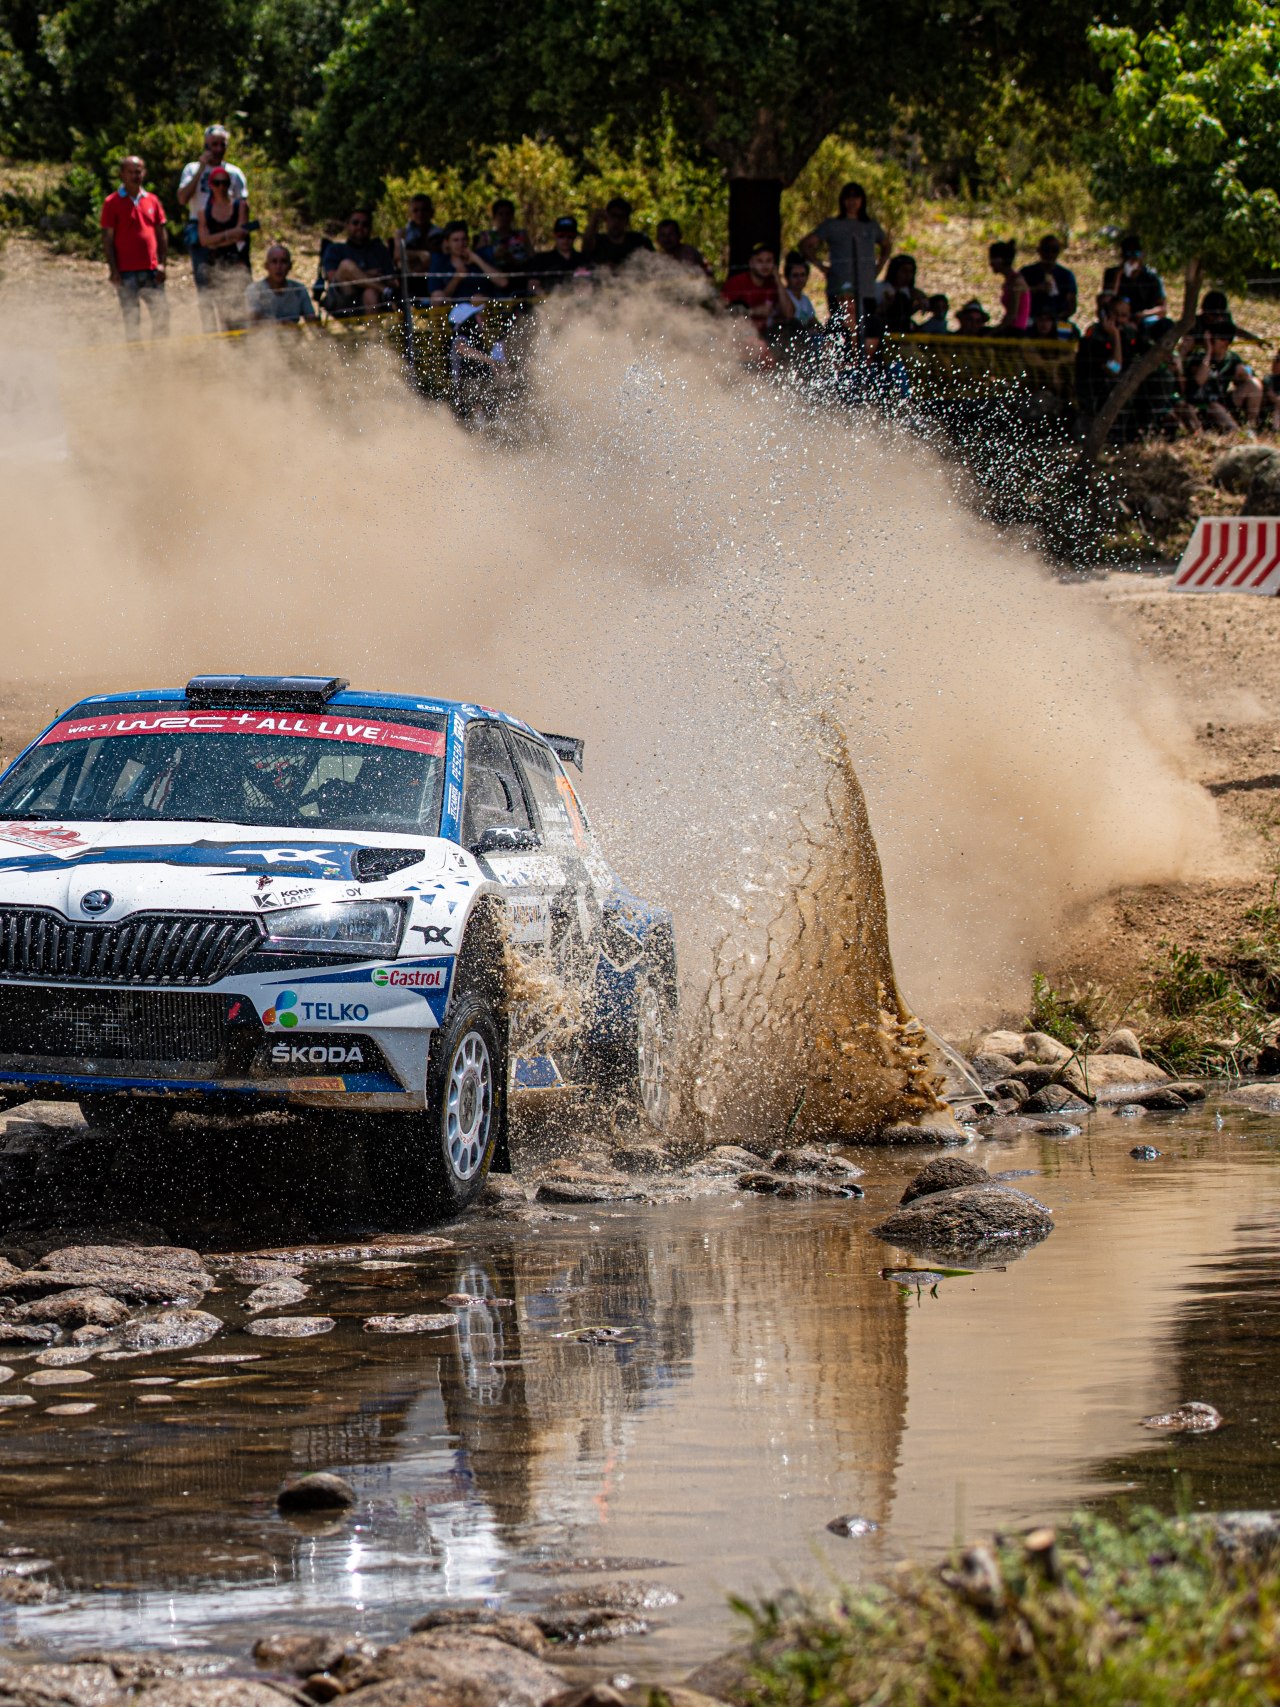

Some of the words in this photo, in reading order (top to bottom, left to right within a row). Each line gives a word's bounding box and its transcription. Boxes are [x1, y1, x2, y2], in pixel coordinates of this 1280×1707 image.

[68, 724, 94, 734] WRC
[97, 723, 108, 731] 3
[256, 718, 309, 732] ALL
[317, 723, 381, 740] LIVE
[346, 888, 362, 897] OY
[389, 970, 441, 986] Castrol
[301, 1002, 369, 1021] TELKO
[271, 1043, 364, 1063] ŠKODA
